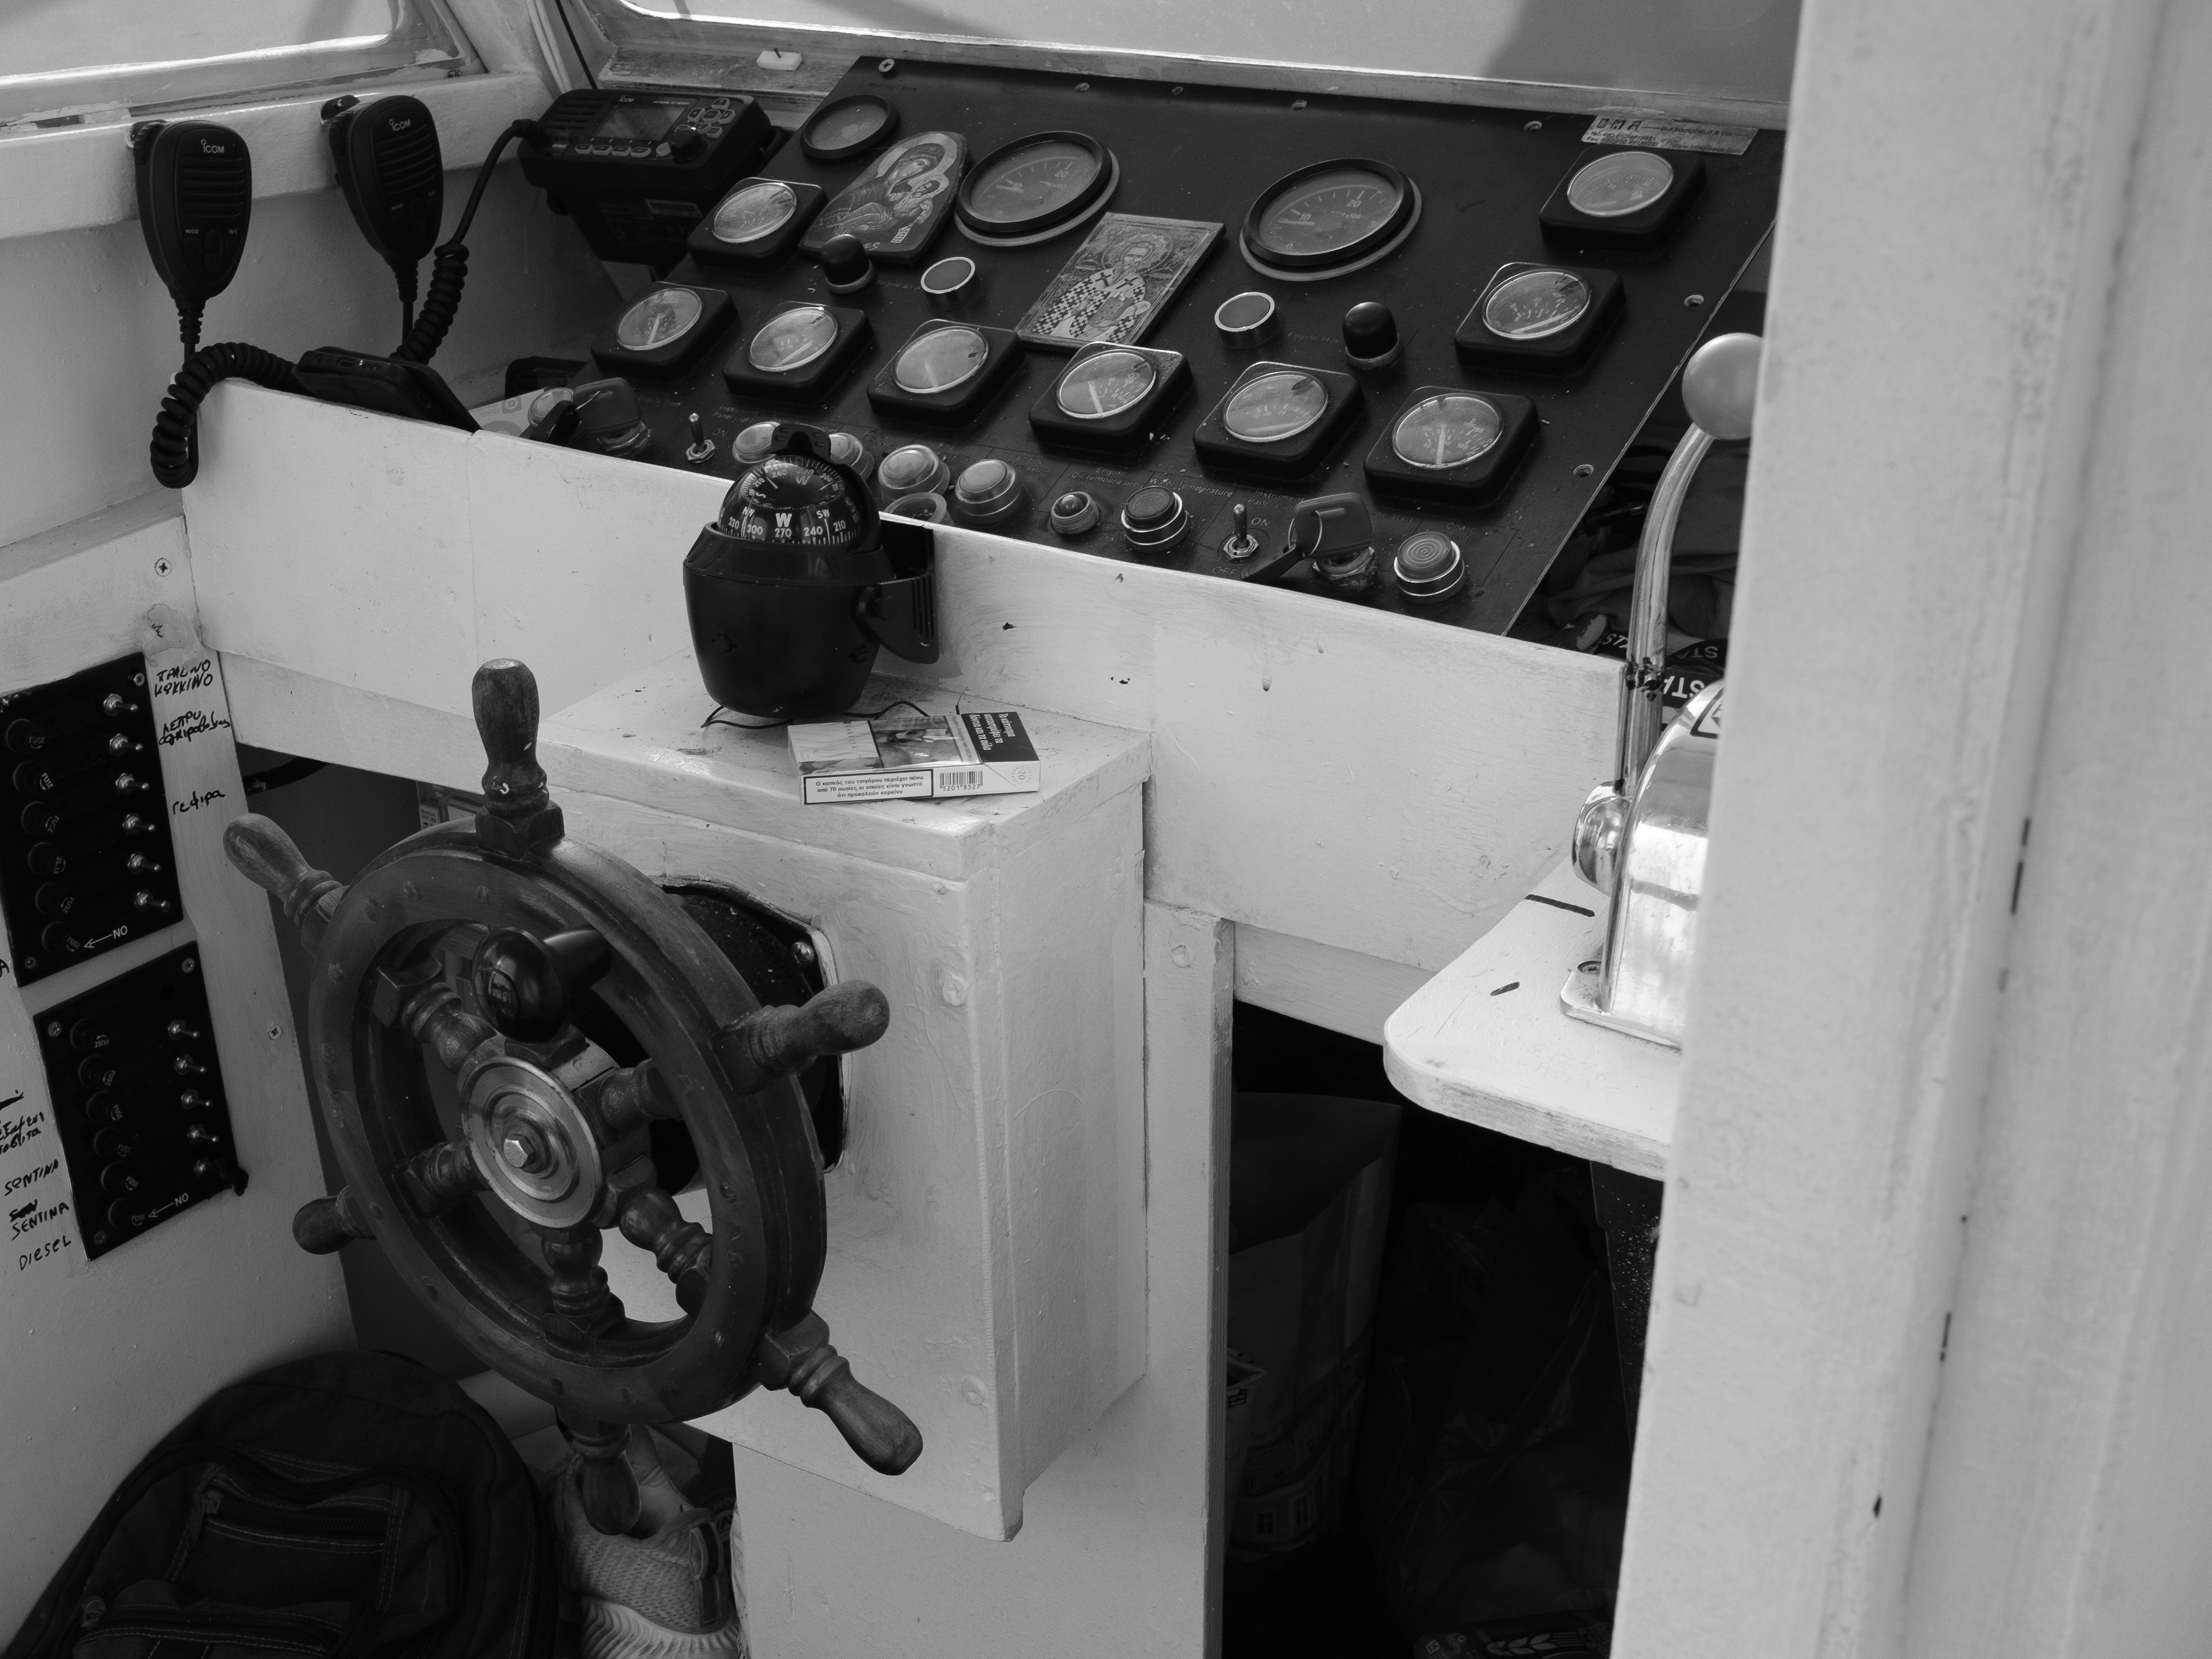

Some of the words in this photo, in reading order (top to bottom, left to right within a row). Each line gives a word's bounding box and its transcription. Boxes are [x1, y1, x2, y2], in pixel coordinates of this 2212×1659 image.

[742, 506, 756, 517] NW
[816, 508, 830, 519] SW
[728, 517, 739, 530] 330
[775, 513, 792, 528] W
[833, 520, 846, 532] 210
[1251, 517, 1270, 526] ON
[747, 524, 763, 535] 300
[774, 528, 792, 538] 270
[803, 526, 823, 537] 240
[41, 772, 53, 790] FUSE
[47, 815, 59, 833] FUSE
[54, 856, 63, 874] FUSE
[62, 897, 74, 914] FUSE
[67, 937, 81, 949] FUSE
[94, 1038, 109, 1048] FUSE
[105, 1070, 116, 1086] FUSE
[113, 1104, 123, 1120] FUSE
[117, 1144, 132, 1153] FUSE
[126, 1176, 139, 1188] FUSE
[131, 1214, 145, 1222] FUSE
